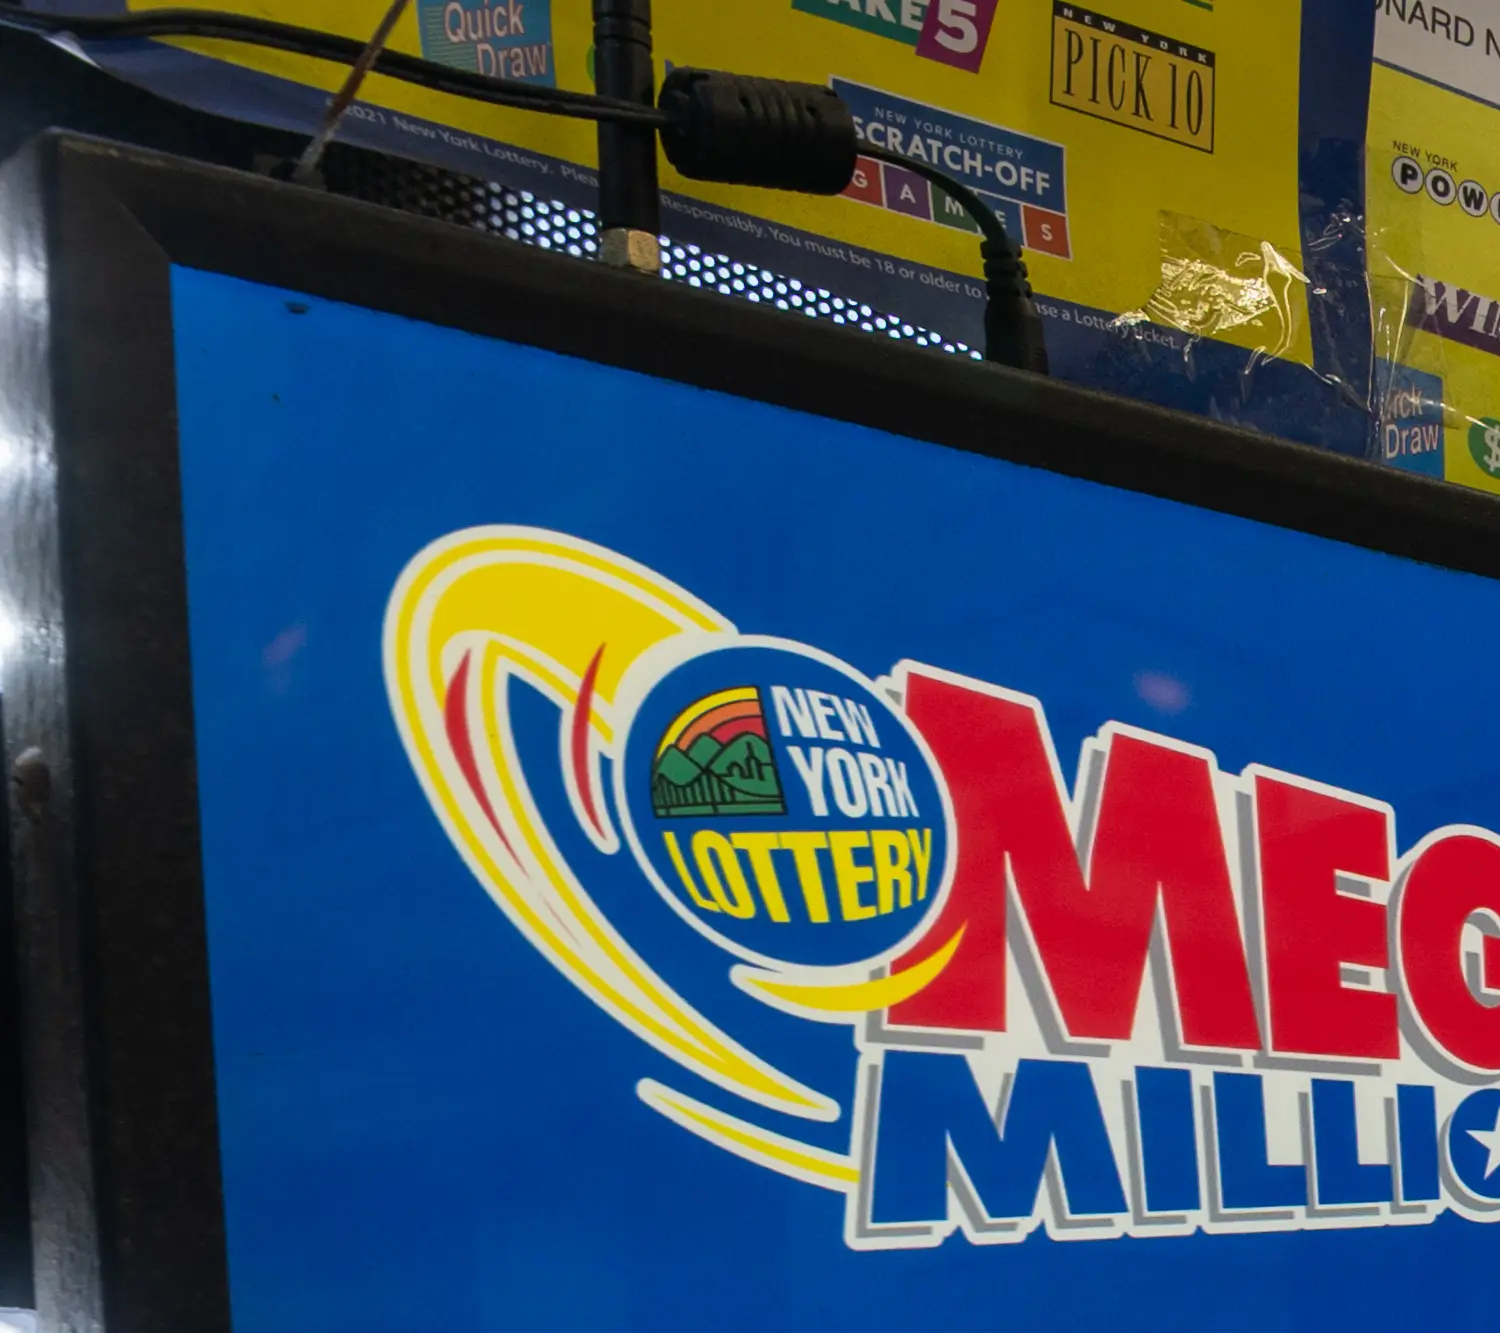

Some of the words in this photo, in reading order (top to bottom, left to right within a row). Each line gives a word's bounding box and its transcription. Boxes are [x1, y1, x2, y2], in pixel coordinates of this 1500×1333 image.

[443, 0, 526, 44] Quick
[1063, 7, 1115, 34] NEW
[1141, 33, 1209, 65] YORK
[1375, 0, 1475, 48] NARD
[475, 41, 550, 79] Draw
[1063, 28, 1154, 122] PICK
[1167, 62, 1203, 137] 10
[851, 115, 1051, 197] SCRATCH-OFF
[873, 106, 908, 127] NEW
[912, 116, 954, 141] YORK
[959, 130, 1024, 161] LOTTERY
[1392, 140, 1420, 158] NEW
[1424, 150, 1458, 172] YORK
[1384, 418, 1439, 460] Draw
[771, 683, 878, 751] NEW
[787, 744, 922, 820] YORK
[662, 827, 933, 926] LOTTERY
